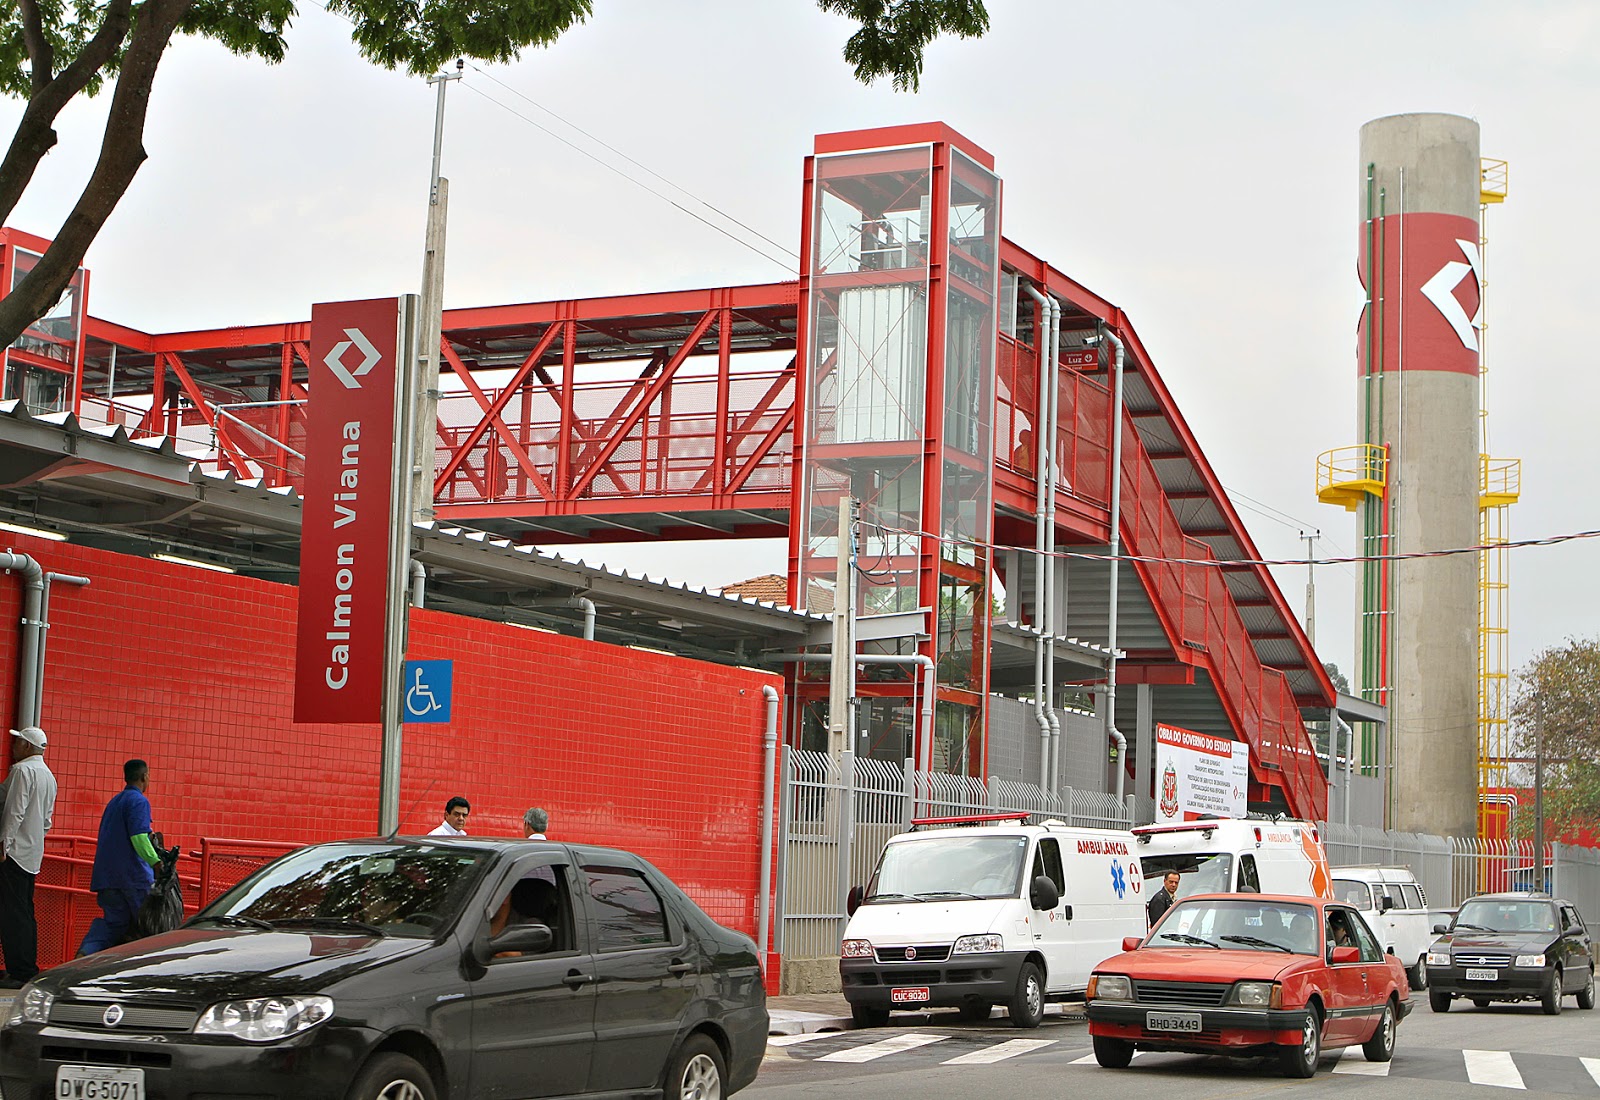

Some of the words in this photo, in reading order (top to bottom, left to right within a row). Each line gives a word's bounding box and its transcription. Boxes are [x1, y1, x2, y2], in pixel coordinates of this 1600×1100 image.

[333, 420, 361, 529] Viana
[325, 543, 355, 690] Calmon
[1158, 727, 1173, 742] OBRA
[1173, 730, 1182, 744] DO
[1182, 733, 1206, 749] GOVERNO
[1205, 738, 1214, 750] DO
[1214, 740, 1231, 754] ESTADO
[1077, 838, 1129, 856] AMBULÂNCIA
[893, 992, 927, 1000] CUC-9020
[60, 1079, 138, 1100] DWG-5071
